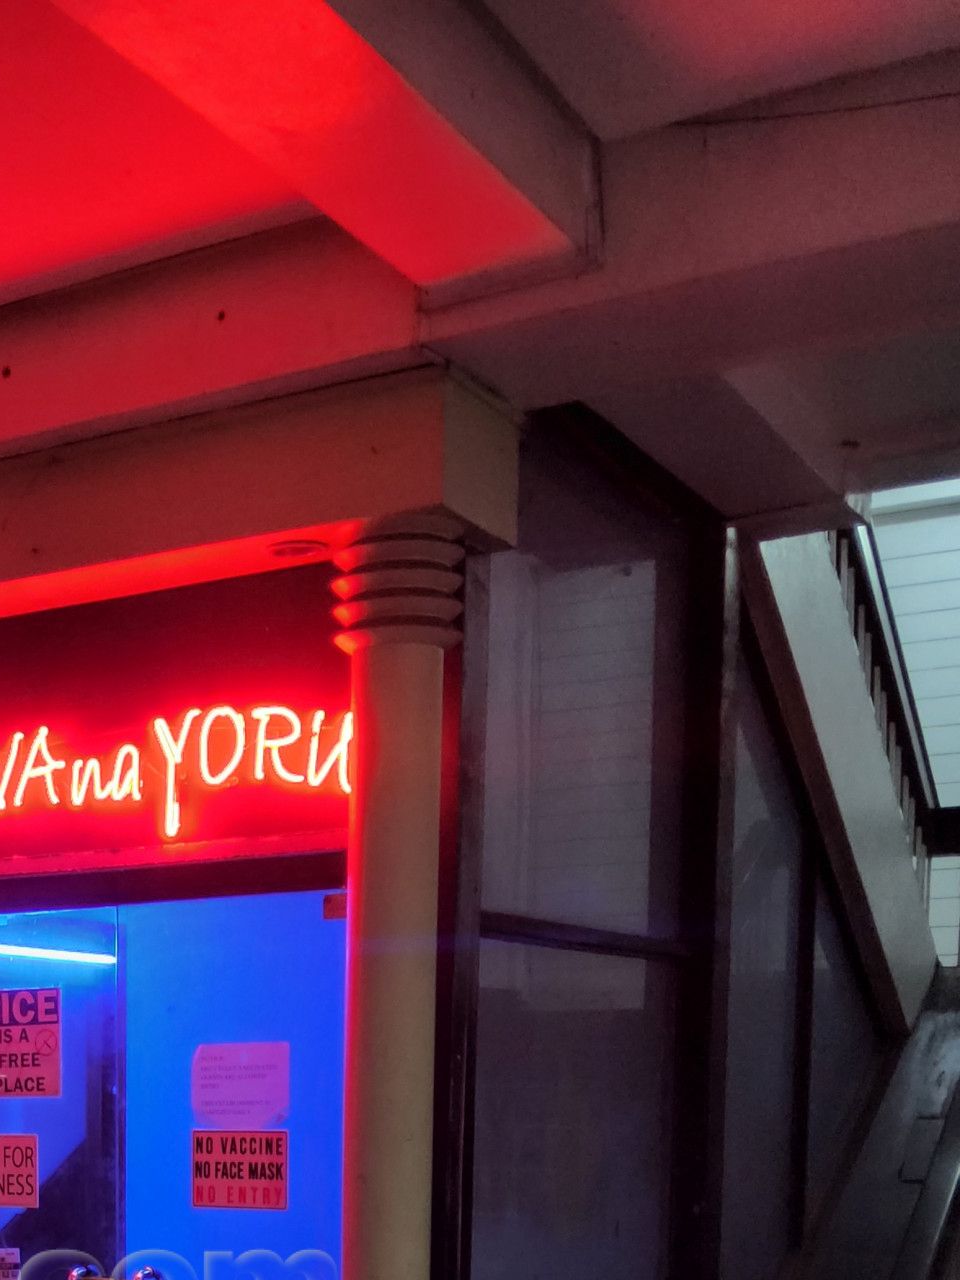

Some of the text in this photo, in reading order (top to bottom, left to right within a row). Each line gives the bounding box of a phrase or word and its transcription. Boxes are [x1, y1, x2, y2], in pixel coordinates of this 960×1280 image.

[70, 743, 143, 807] na
[19, 1028, 29, 1043] A
[195, 1136, 284, 1156] NO VACCINE
[3, 1146, 34, 1169] FOR
[195, 1160, 284, 1181] NO FACE MASK
[196, 1185, 283, 1207] NO ENTRY
